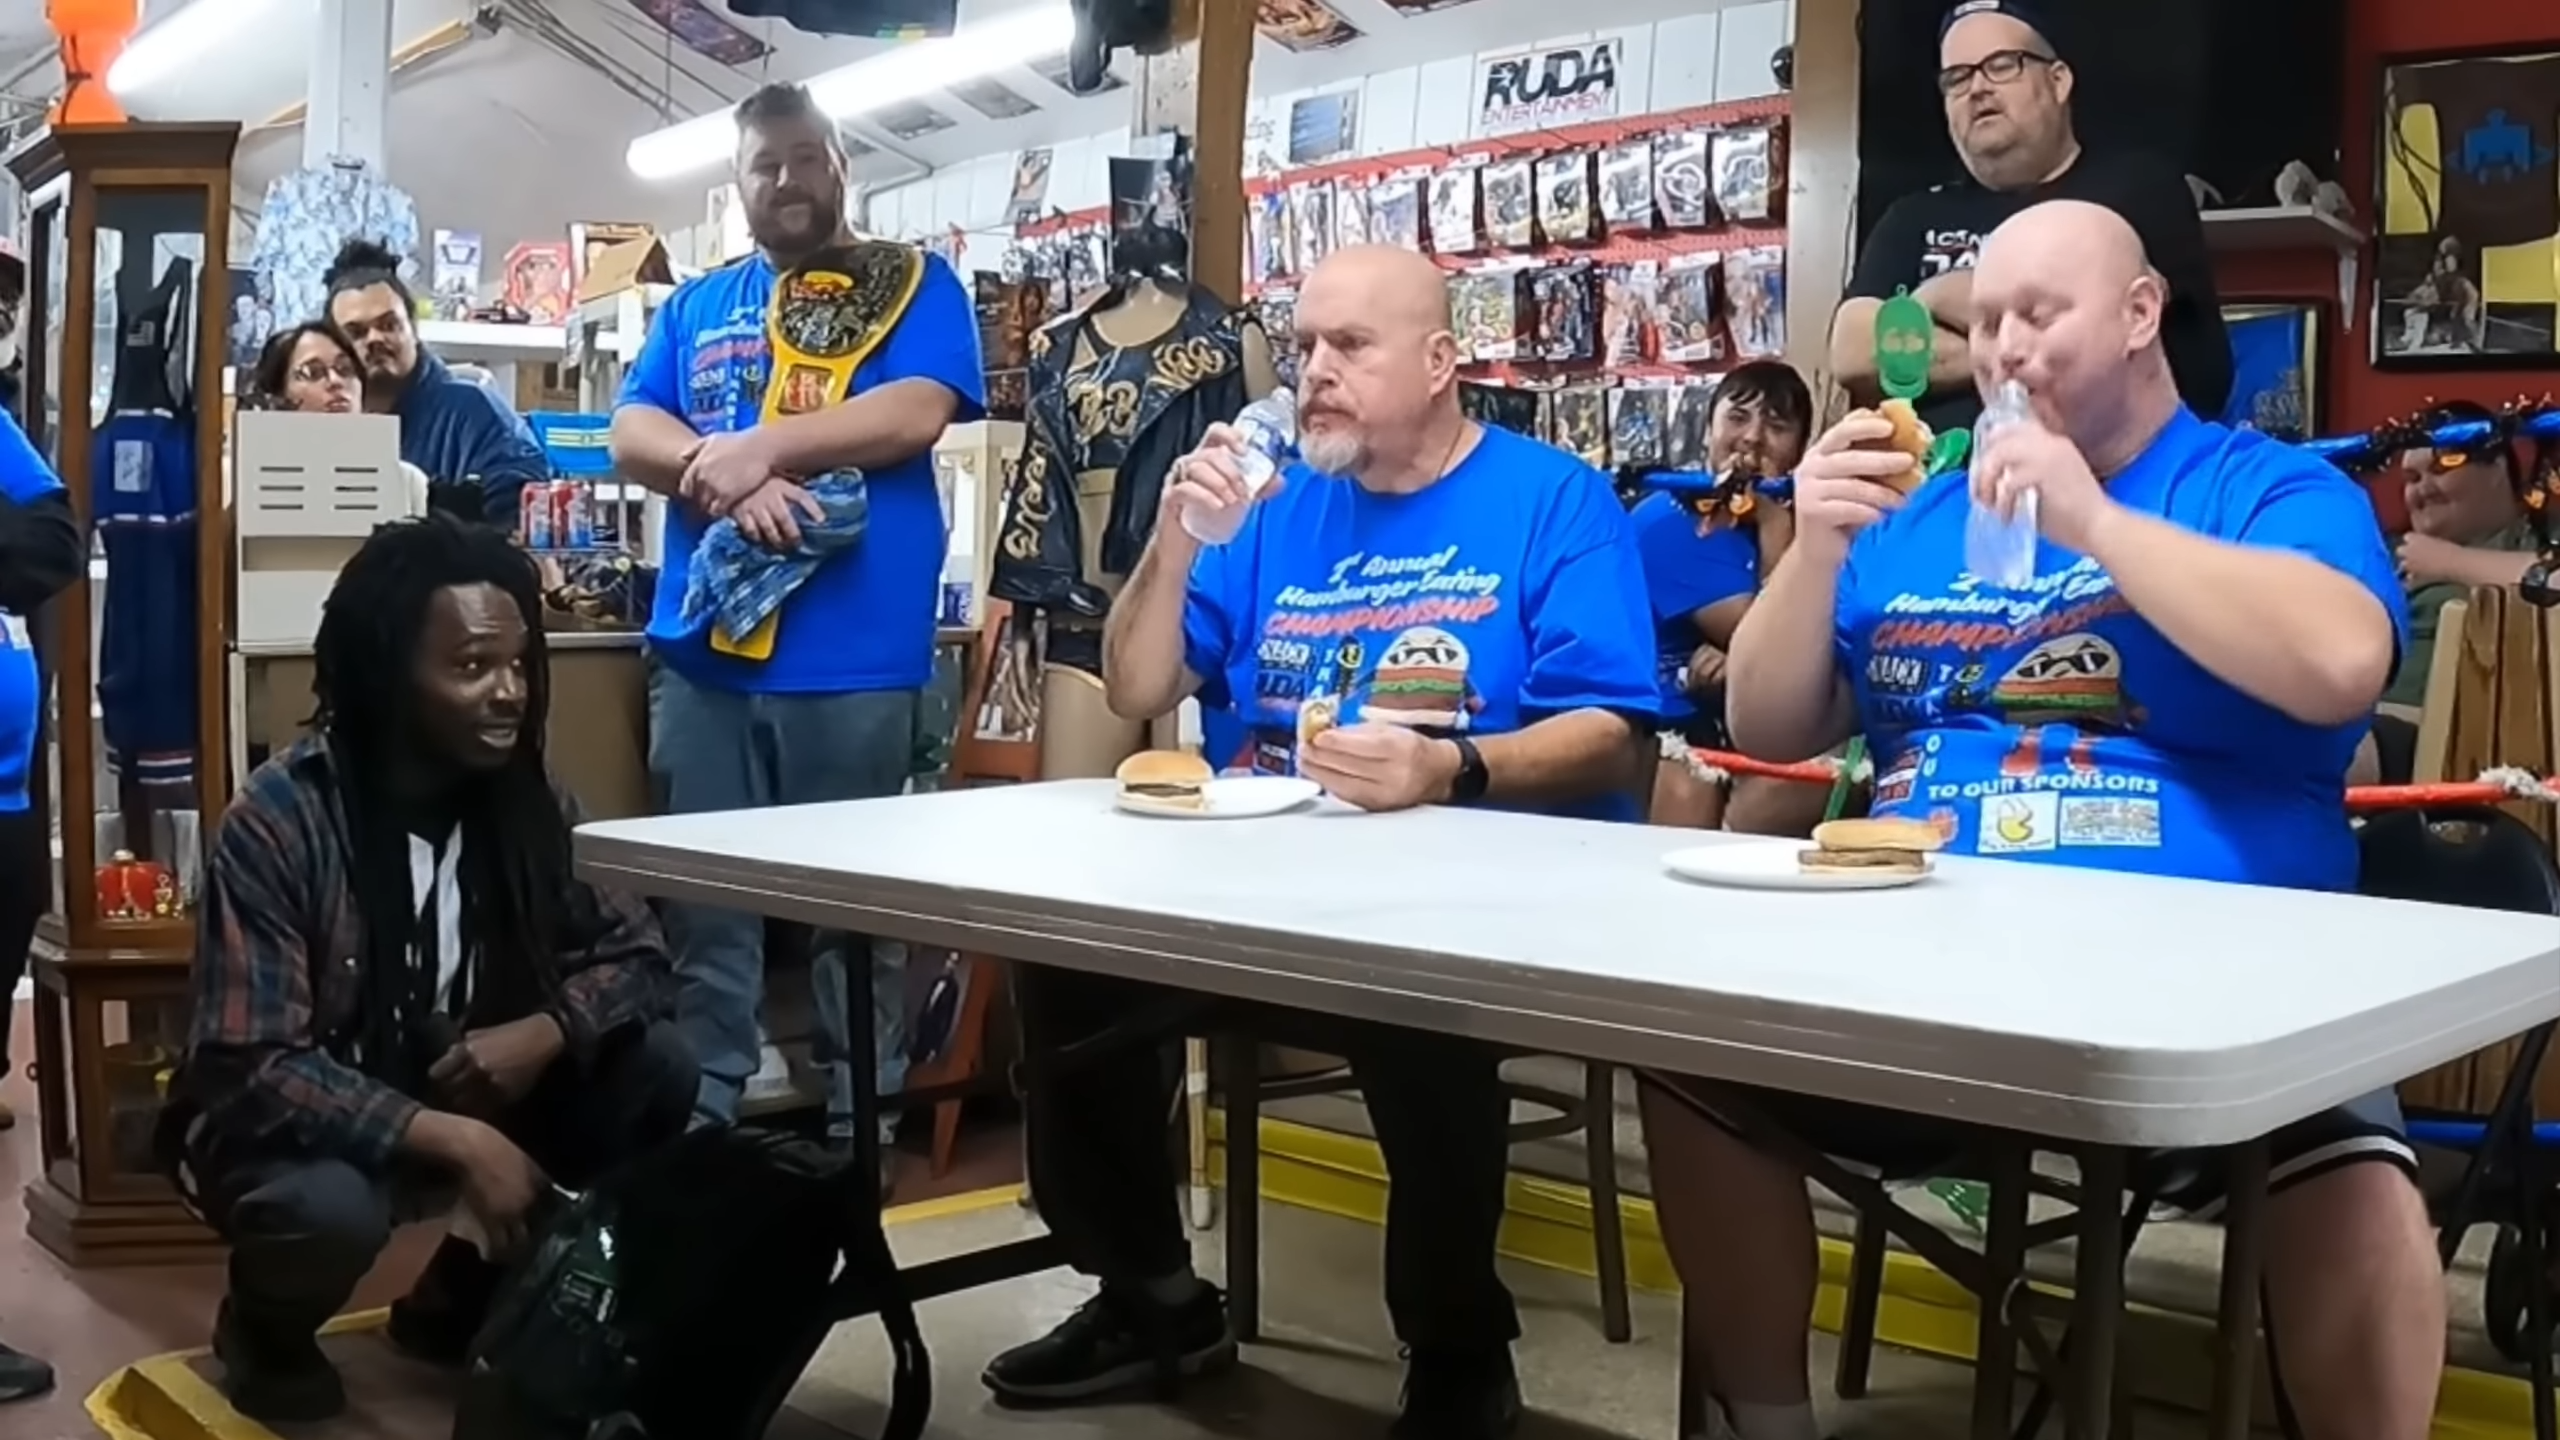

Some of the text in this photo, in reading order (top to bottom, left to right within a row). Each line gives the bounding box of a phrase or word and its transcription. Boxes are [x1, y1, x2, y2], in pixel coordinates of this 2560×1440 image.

[1484, 44, 1615, 111] RUDA
[1480, 92, 1612, 126] ENTERTAINMENT
[1360, 545, 1459, 577] Annual
[1275, 566, 1502, 607] Hamburger Eating
[1264, 596, 1500, 637] CHAMPIONSHIP
[1928, 783, 1959, 800] TO
[1962, 776, 2016, 797] OUR
[2019, 772, 2160, 794] SPONSORS
